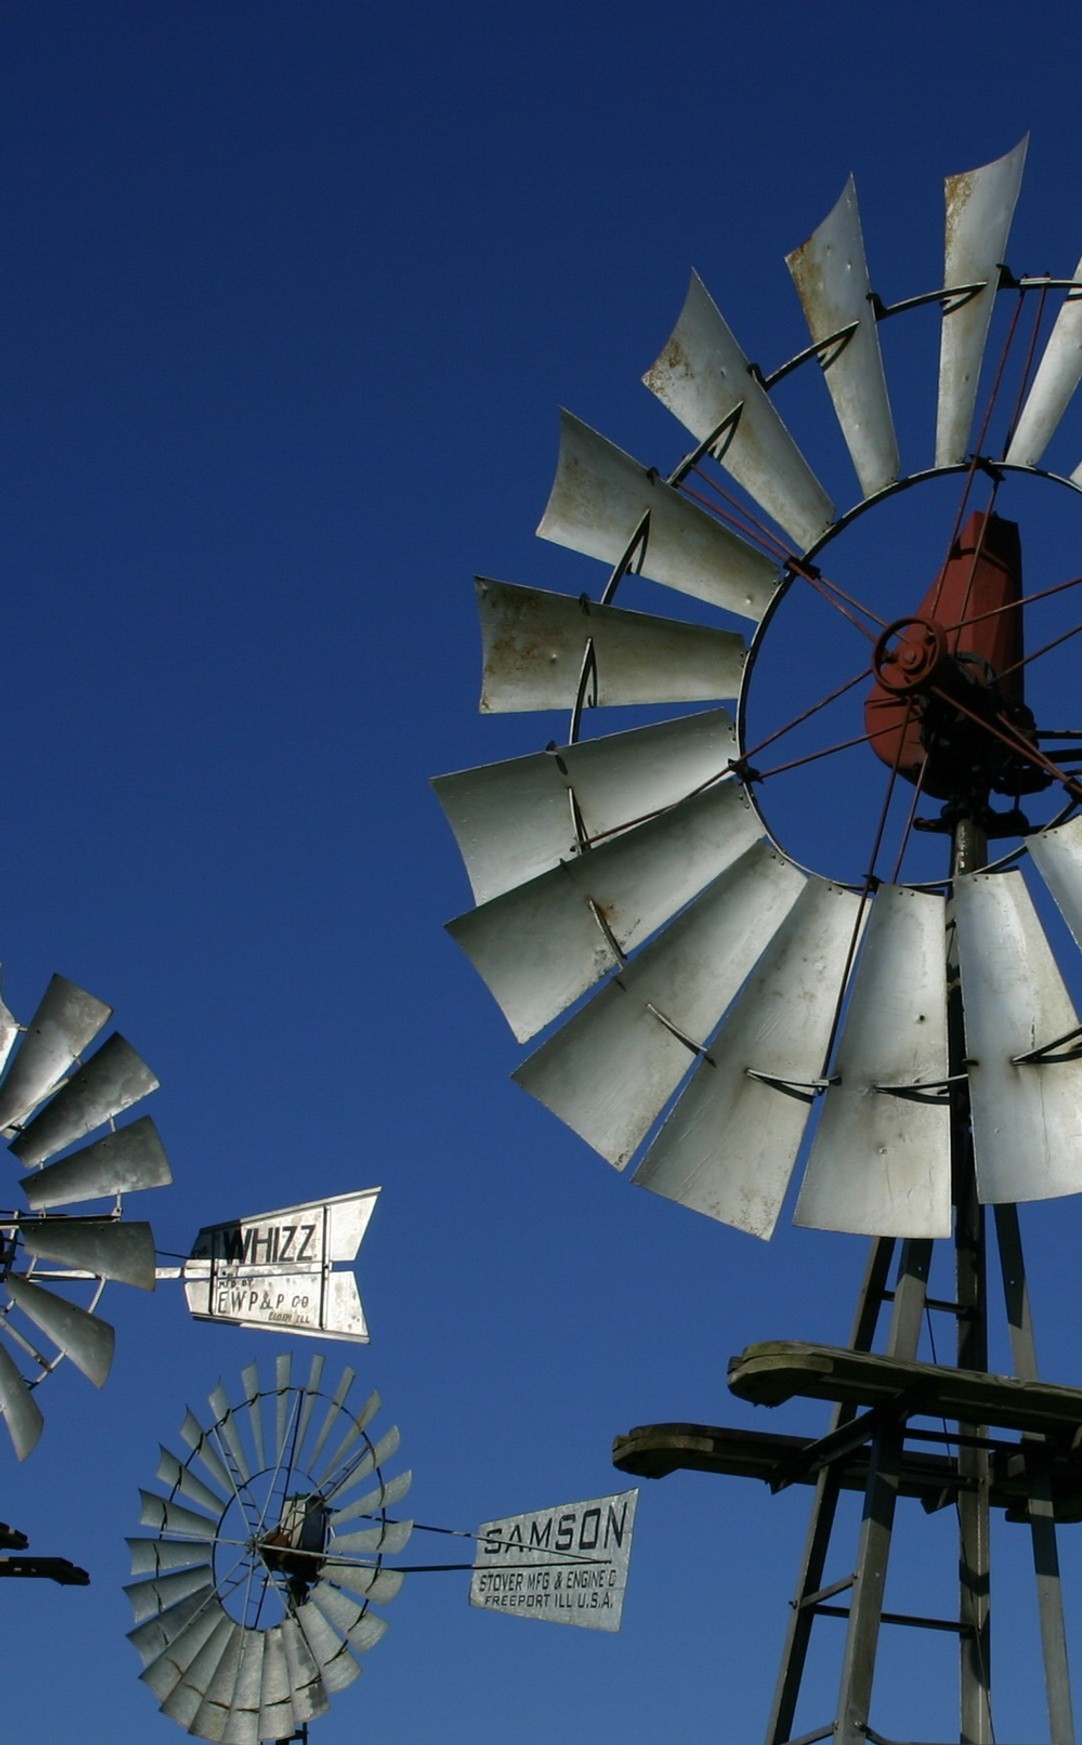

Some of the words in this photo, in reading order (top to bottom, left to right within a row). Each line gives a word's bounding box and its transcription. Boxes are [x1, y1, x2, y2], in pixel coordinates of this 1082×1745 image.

[222, 1224, 317, 1265] WHIZZ
[484, 1502, 628, 1554] SAMSON
[479, 1573, 523, 1592] STOVER
[527, 1570, 550, 1590] MFG
[554, 1571, 562, 1590] &
[566, 1569, 605, 1589] ENGINE
[485, 1594, 550, 1607] FREEPORT
[554, 1593, 573, 1608] ILL
